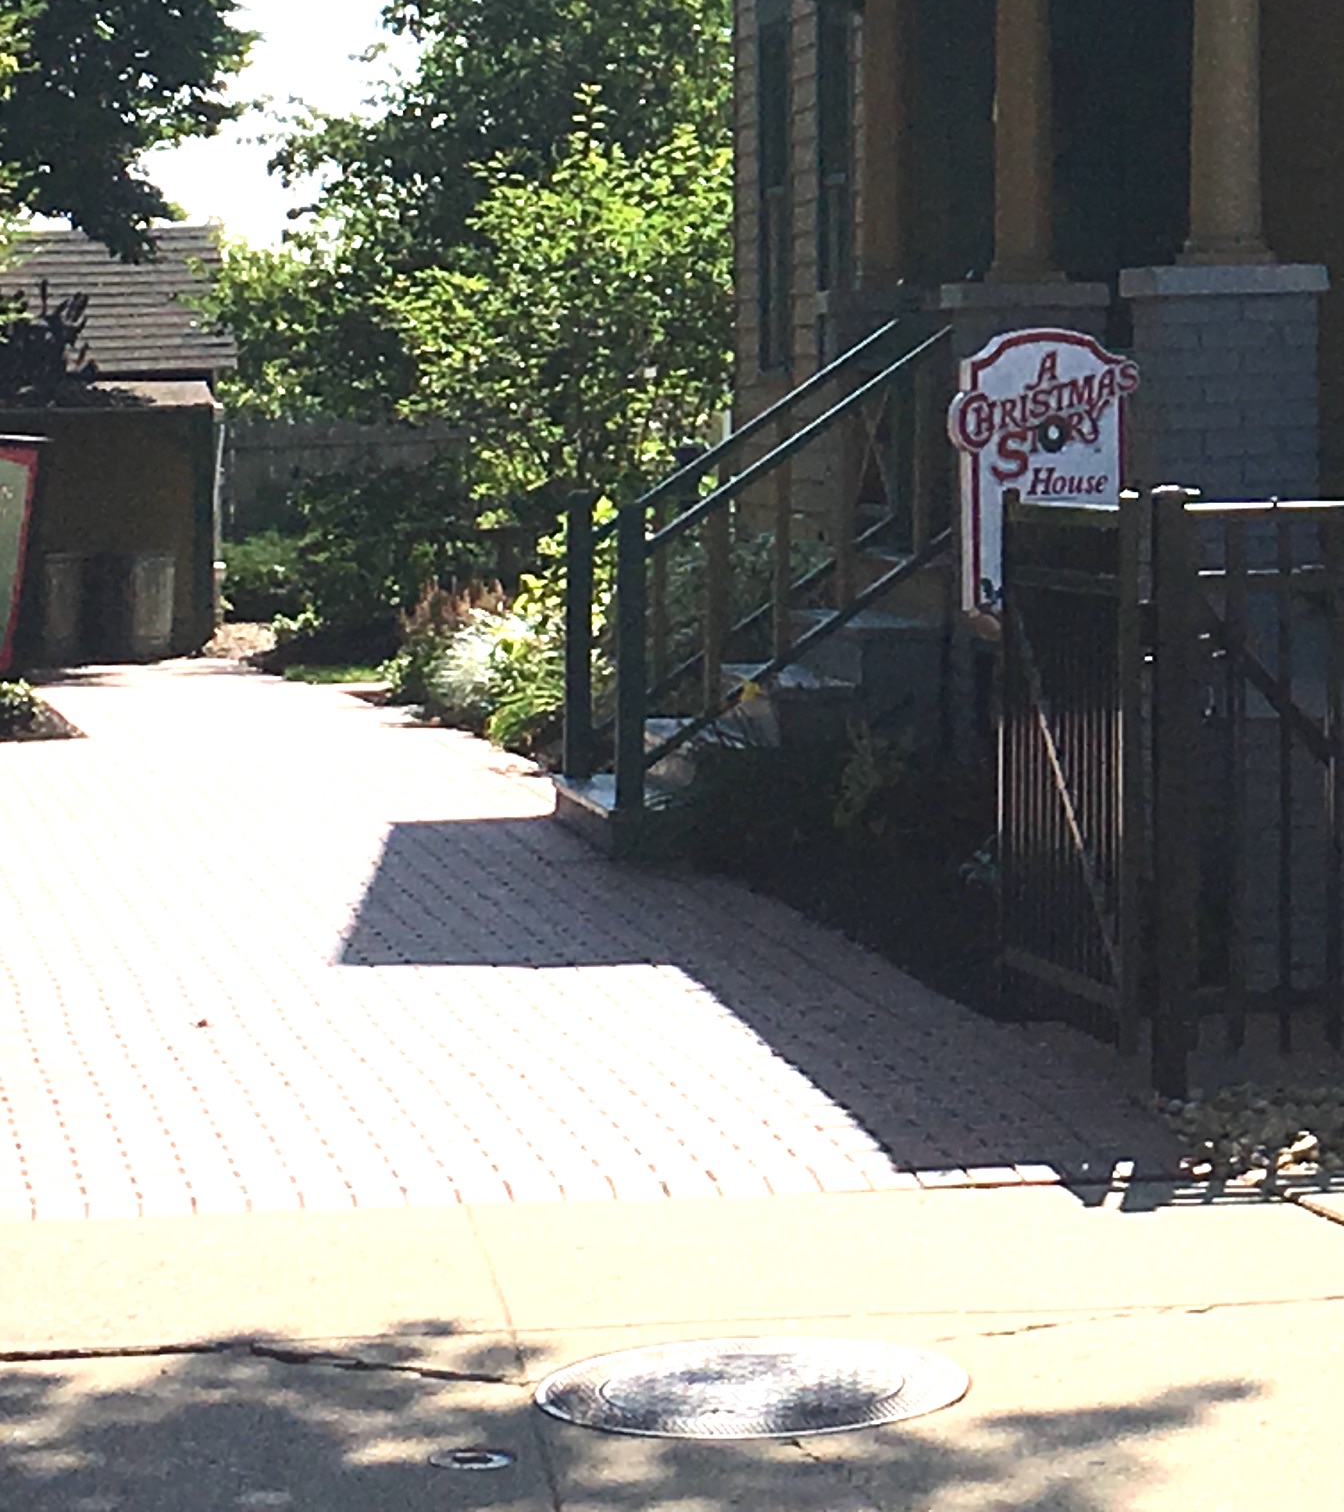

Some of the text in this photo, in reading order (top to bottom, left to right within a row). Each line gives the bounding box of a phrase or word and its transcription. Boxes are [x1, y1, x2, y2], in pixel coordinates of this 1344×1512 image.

[1026, 350, 1059, 392] A
[959, 363, 1138, 450] CHRISTMAS
[991, 399, 1111, 481] STORY
[1026, 467, 1108, 496] House
